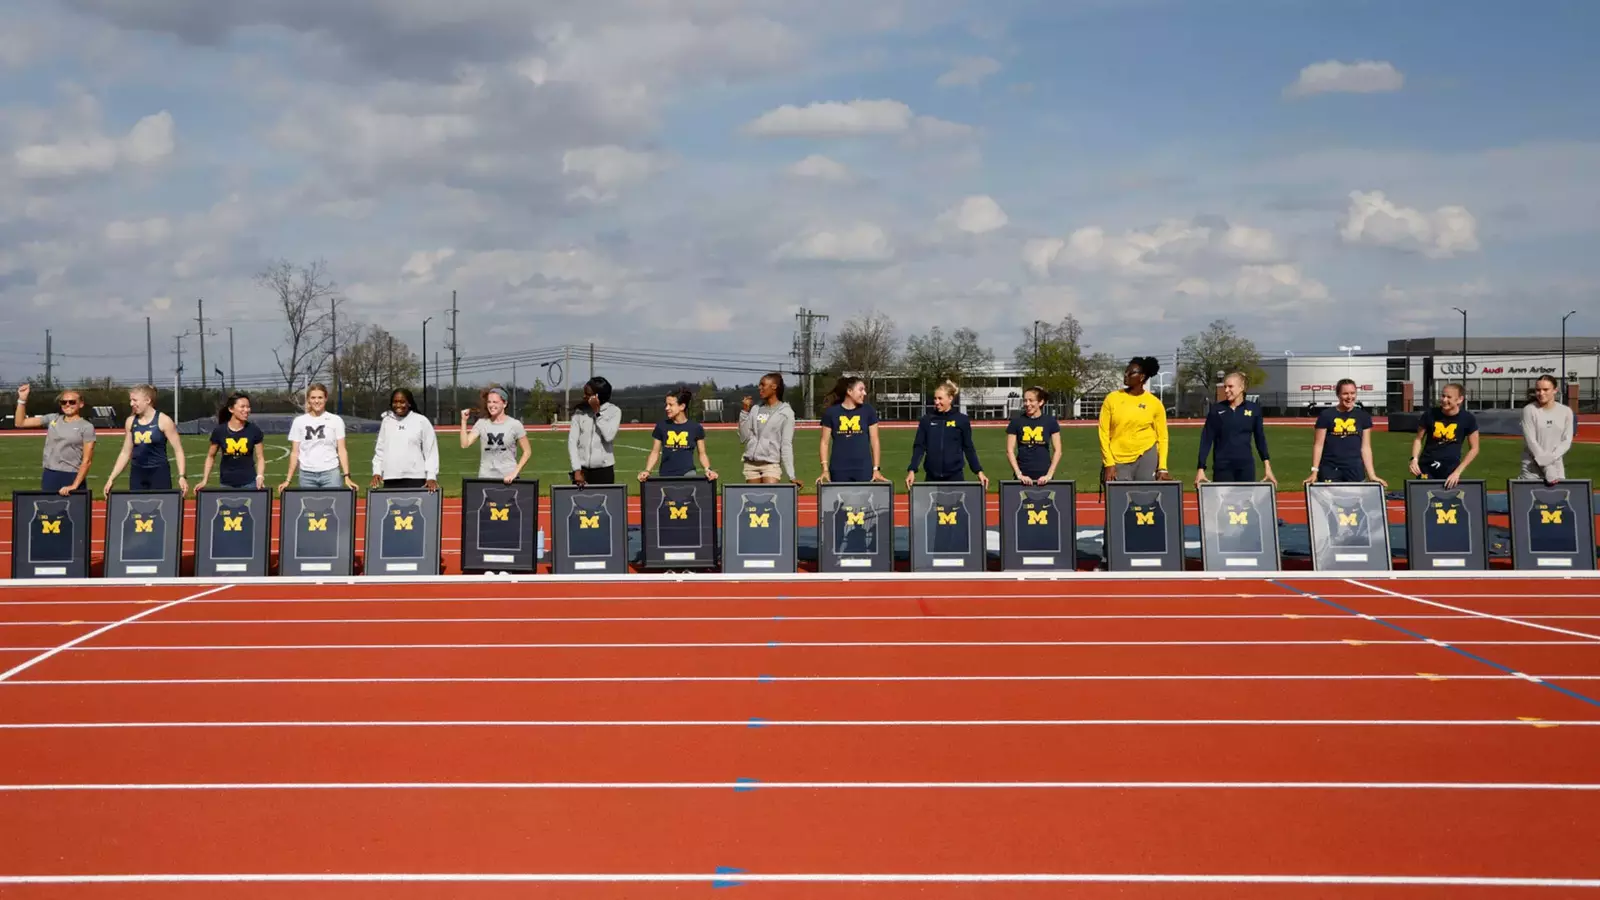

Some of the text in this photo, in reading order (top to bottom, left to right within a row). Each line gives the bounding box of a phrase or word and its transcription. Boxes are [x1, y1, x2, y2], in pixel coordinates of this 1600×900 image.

[1482, 366, 1557, 374] Audi Ann Arbor
[839, 415, 861, 431] M
[1333, 417, 1357, 433] M
[305, 424, 325, 440] M
[1022, 425, 1044, 441] M
[1433, 421, 1458, 439] M
[134, 431, 151, 443] M
[487, 433, 504, 446] M
[666, 430, 689, 446] M
[225, 437, 249, 454] M
[490, 507, 509, 520] M
[669, 505, 688, 519] M
[847, 512, 865, 524] M
[938, 511, 957, 524] M
[1027, 510, 1048, 524] M
[1135, 511, 1155, 524] M
[1229, 512, 1248, 524] M
[1436, 509, 1457, 523] M
[1541, 510, 1562, 523] M
[135, 519, 153, 531] M
[223, 516, 242, 530] M
[308, 518, 327, 530] M
[395, 516, 413, 529] M
[580, 515, 599, 528] M
[750, 513, 769, 526] M
[1339, 513, 1357, 525] M
[42, 520, 61, 533] M
